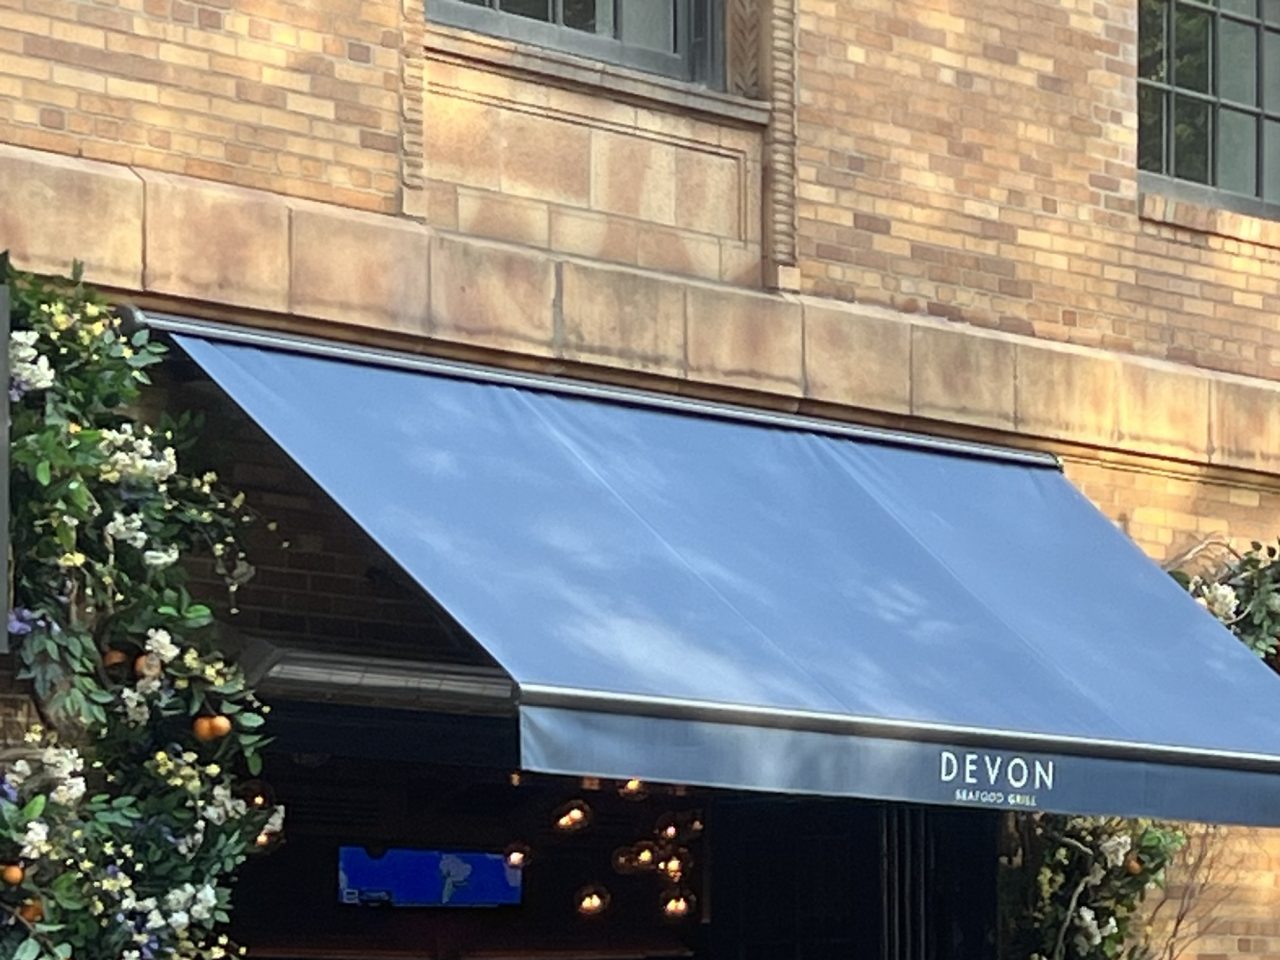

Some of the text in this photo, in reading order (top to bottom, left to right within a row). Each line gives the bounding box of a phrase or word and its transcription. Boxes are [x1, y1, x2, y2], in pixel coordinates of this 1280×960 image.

[940, 751, 1053, 790] DEVON
[955, 788, 1037, 807] SEAFOOD GRILL
